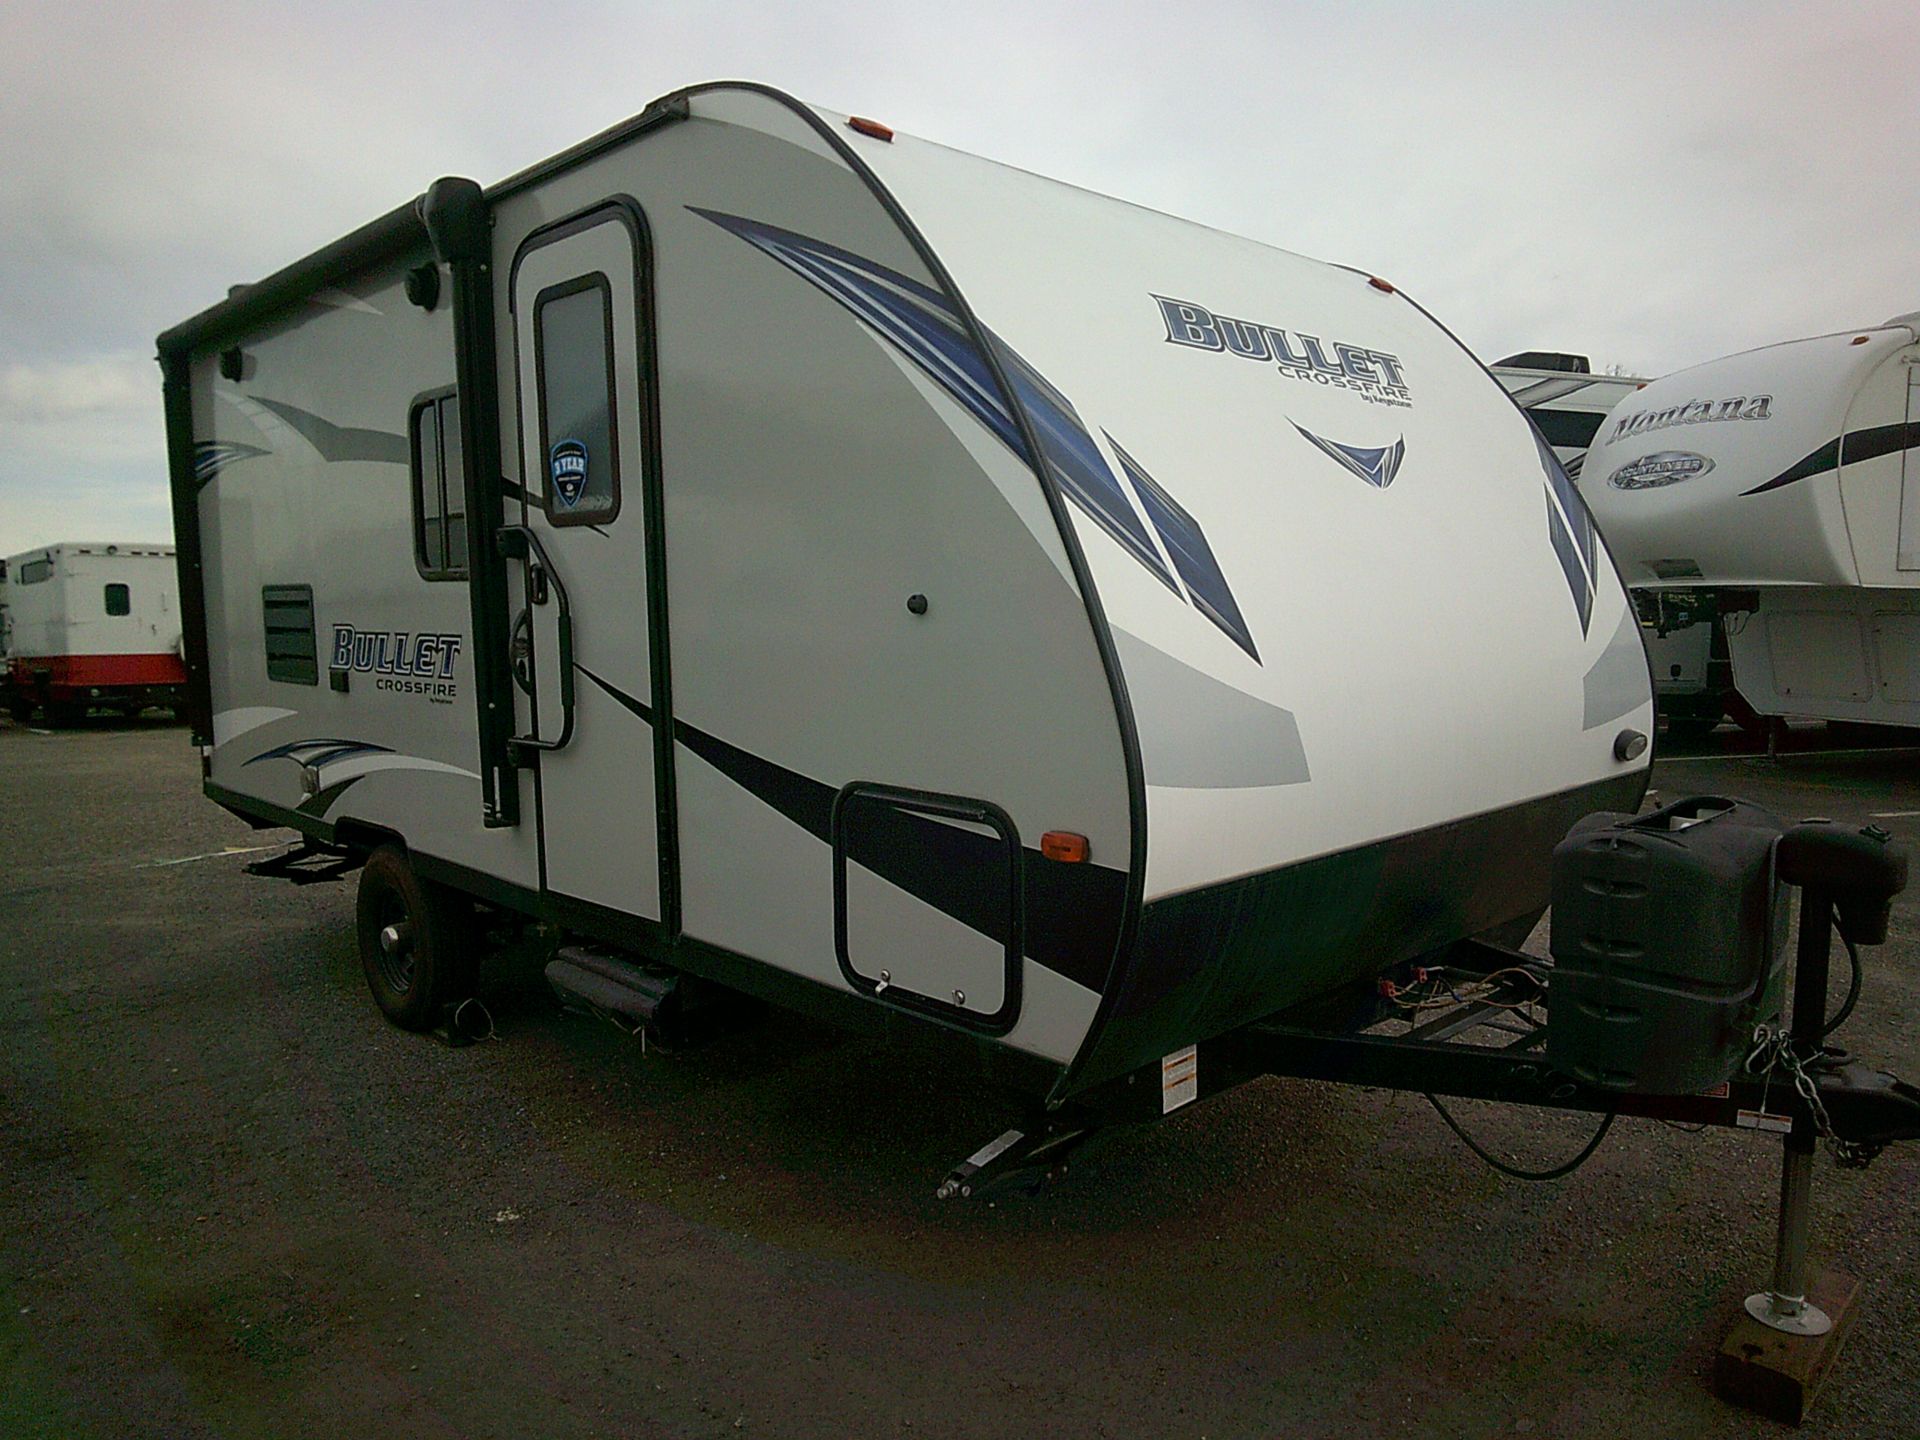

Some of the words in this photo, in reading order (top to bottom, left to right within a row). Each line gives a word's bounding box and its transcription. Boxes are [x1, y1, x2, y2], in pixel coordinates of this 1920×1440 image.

[1149, 293, 1410, 389] BULLET
[1278, 366, 1412, 400] CROSSFIRE
[1605, 395, 1772, 446] Montana
[562, 457, 585, 472] YEAR
[1620, 459, 1701, 477] MOUNTAINEER
[329, 624, 462, 679] BULLET
[376, 678, 457, 697] CROSSFIRE
